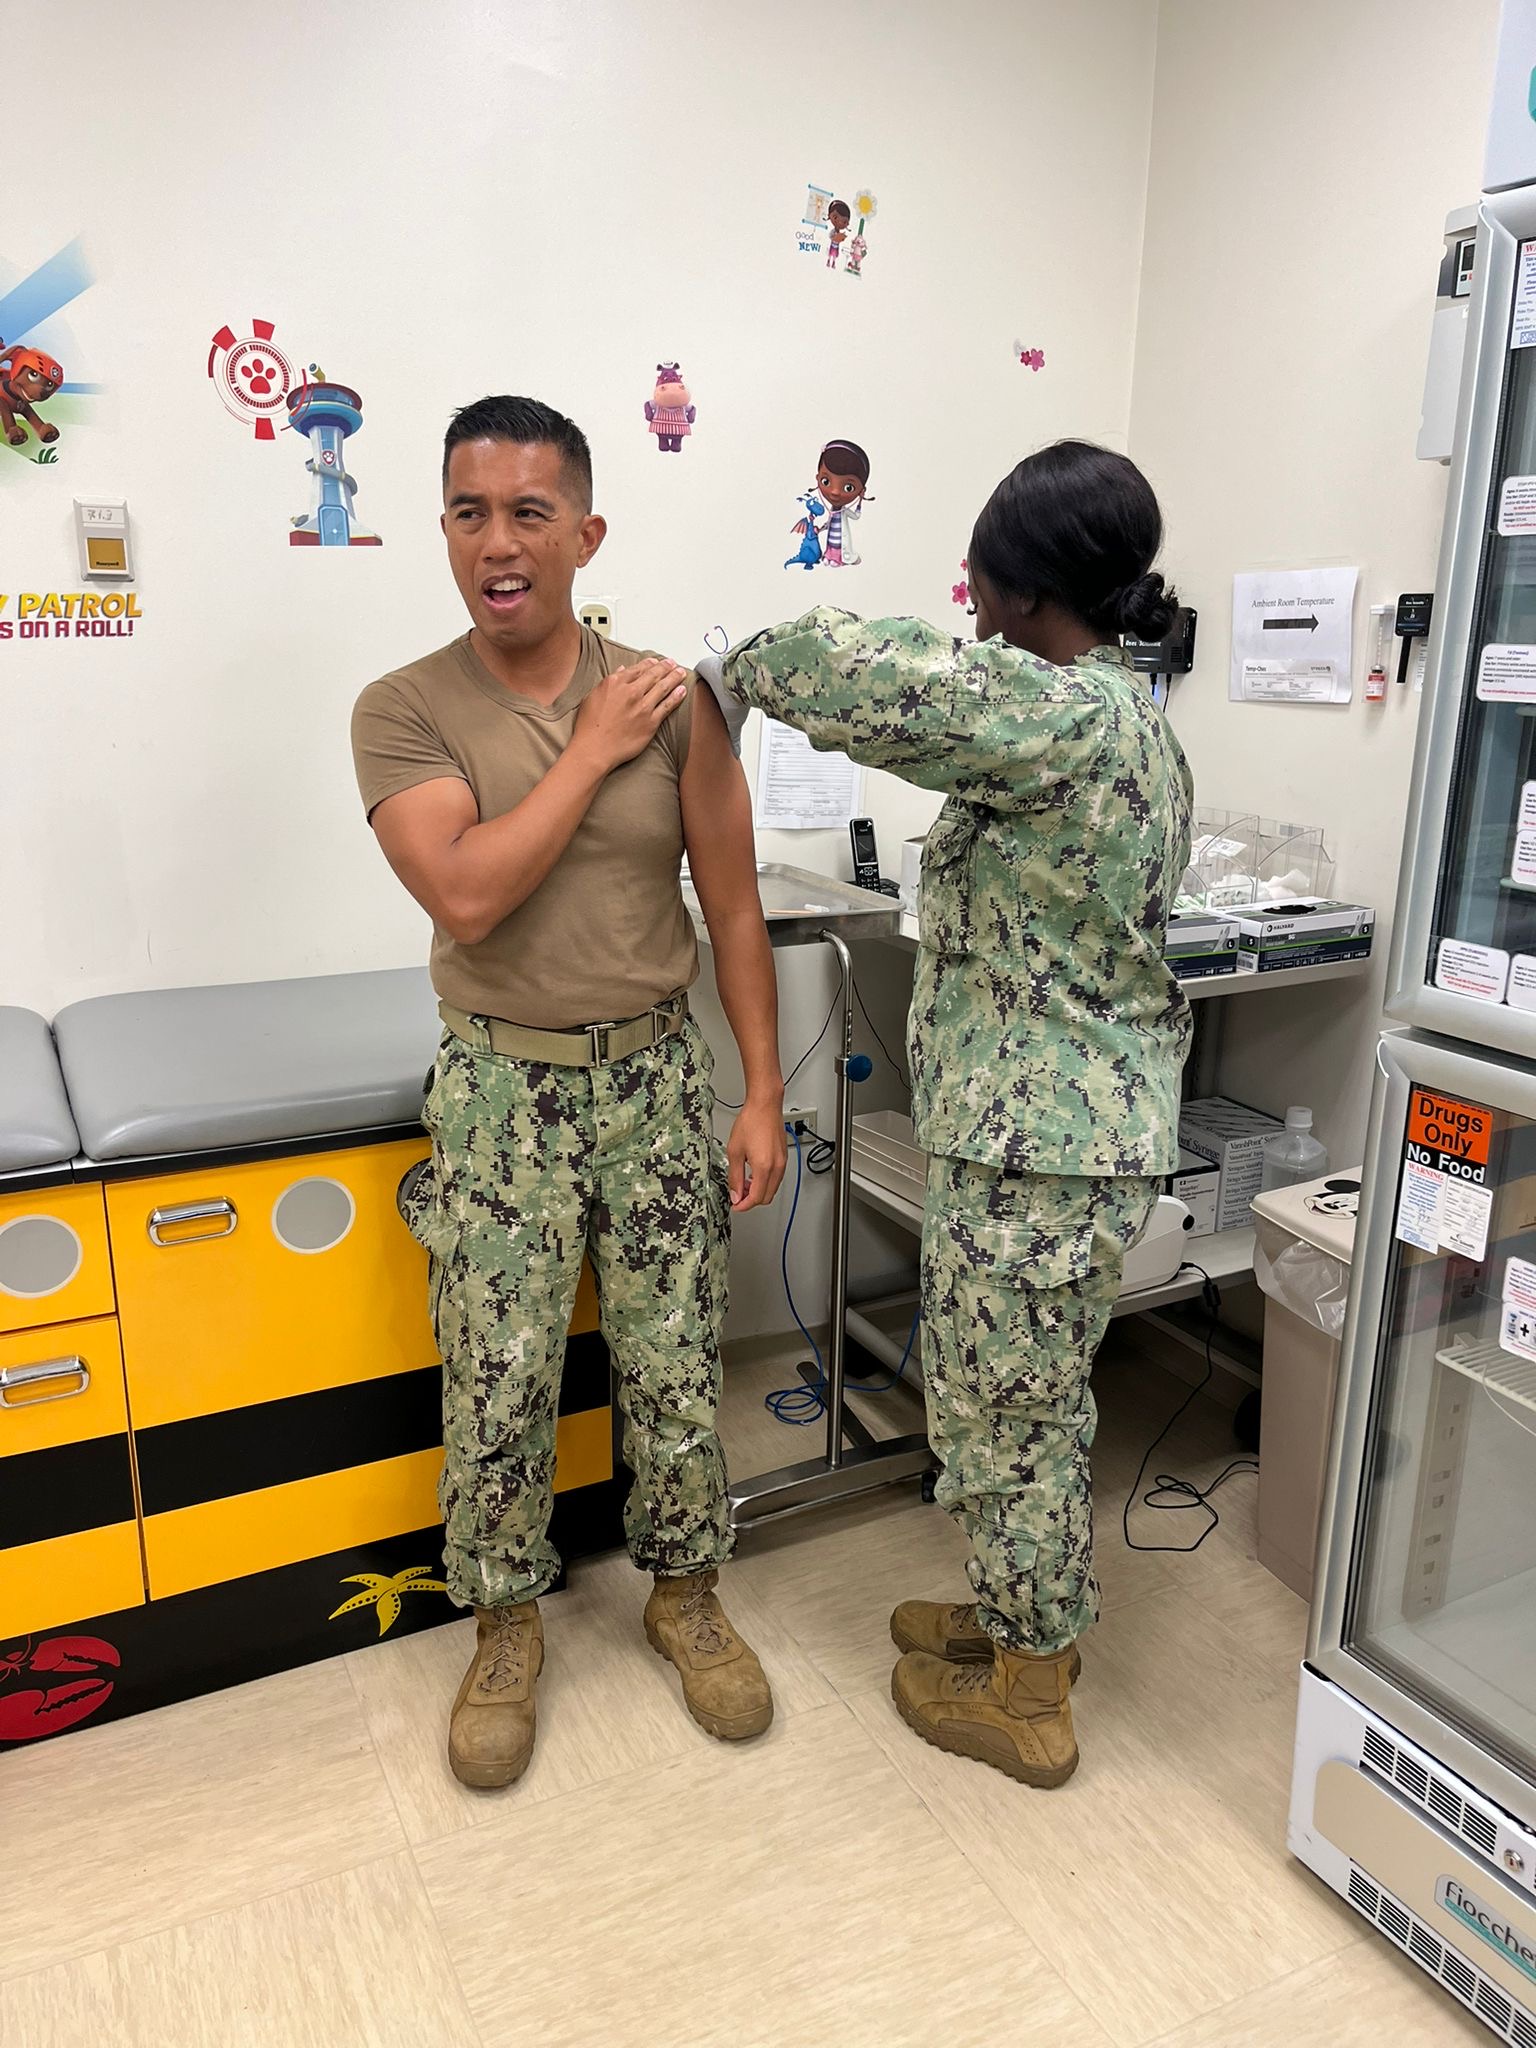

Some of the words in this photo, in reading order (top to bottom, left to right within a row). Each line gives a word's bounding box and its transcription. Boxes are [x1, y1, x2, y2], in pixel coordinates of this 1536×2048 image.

[18, 593, 143, 619] PATROL
[1251, 599, 1277, 608] Ambient
[1277, 598, 1296, 607] Room
[1296, 597, 1336, 607] Temperature
[55, 621, 69, 638] A
[75, 620, 134, 637] ROLL!
[1419, 1096, 1484, 1133] Drugs
[1424, 1123, 1474, 1157] Only
[1407, 1143, 1431, 1165] No
[1438, 1153, 1486, 1184] Food
[1408, 1162, 1444, 1181] WARNING
[1445, 1880, 1536, 1969] Fiocche
